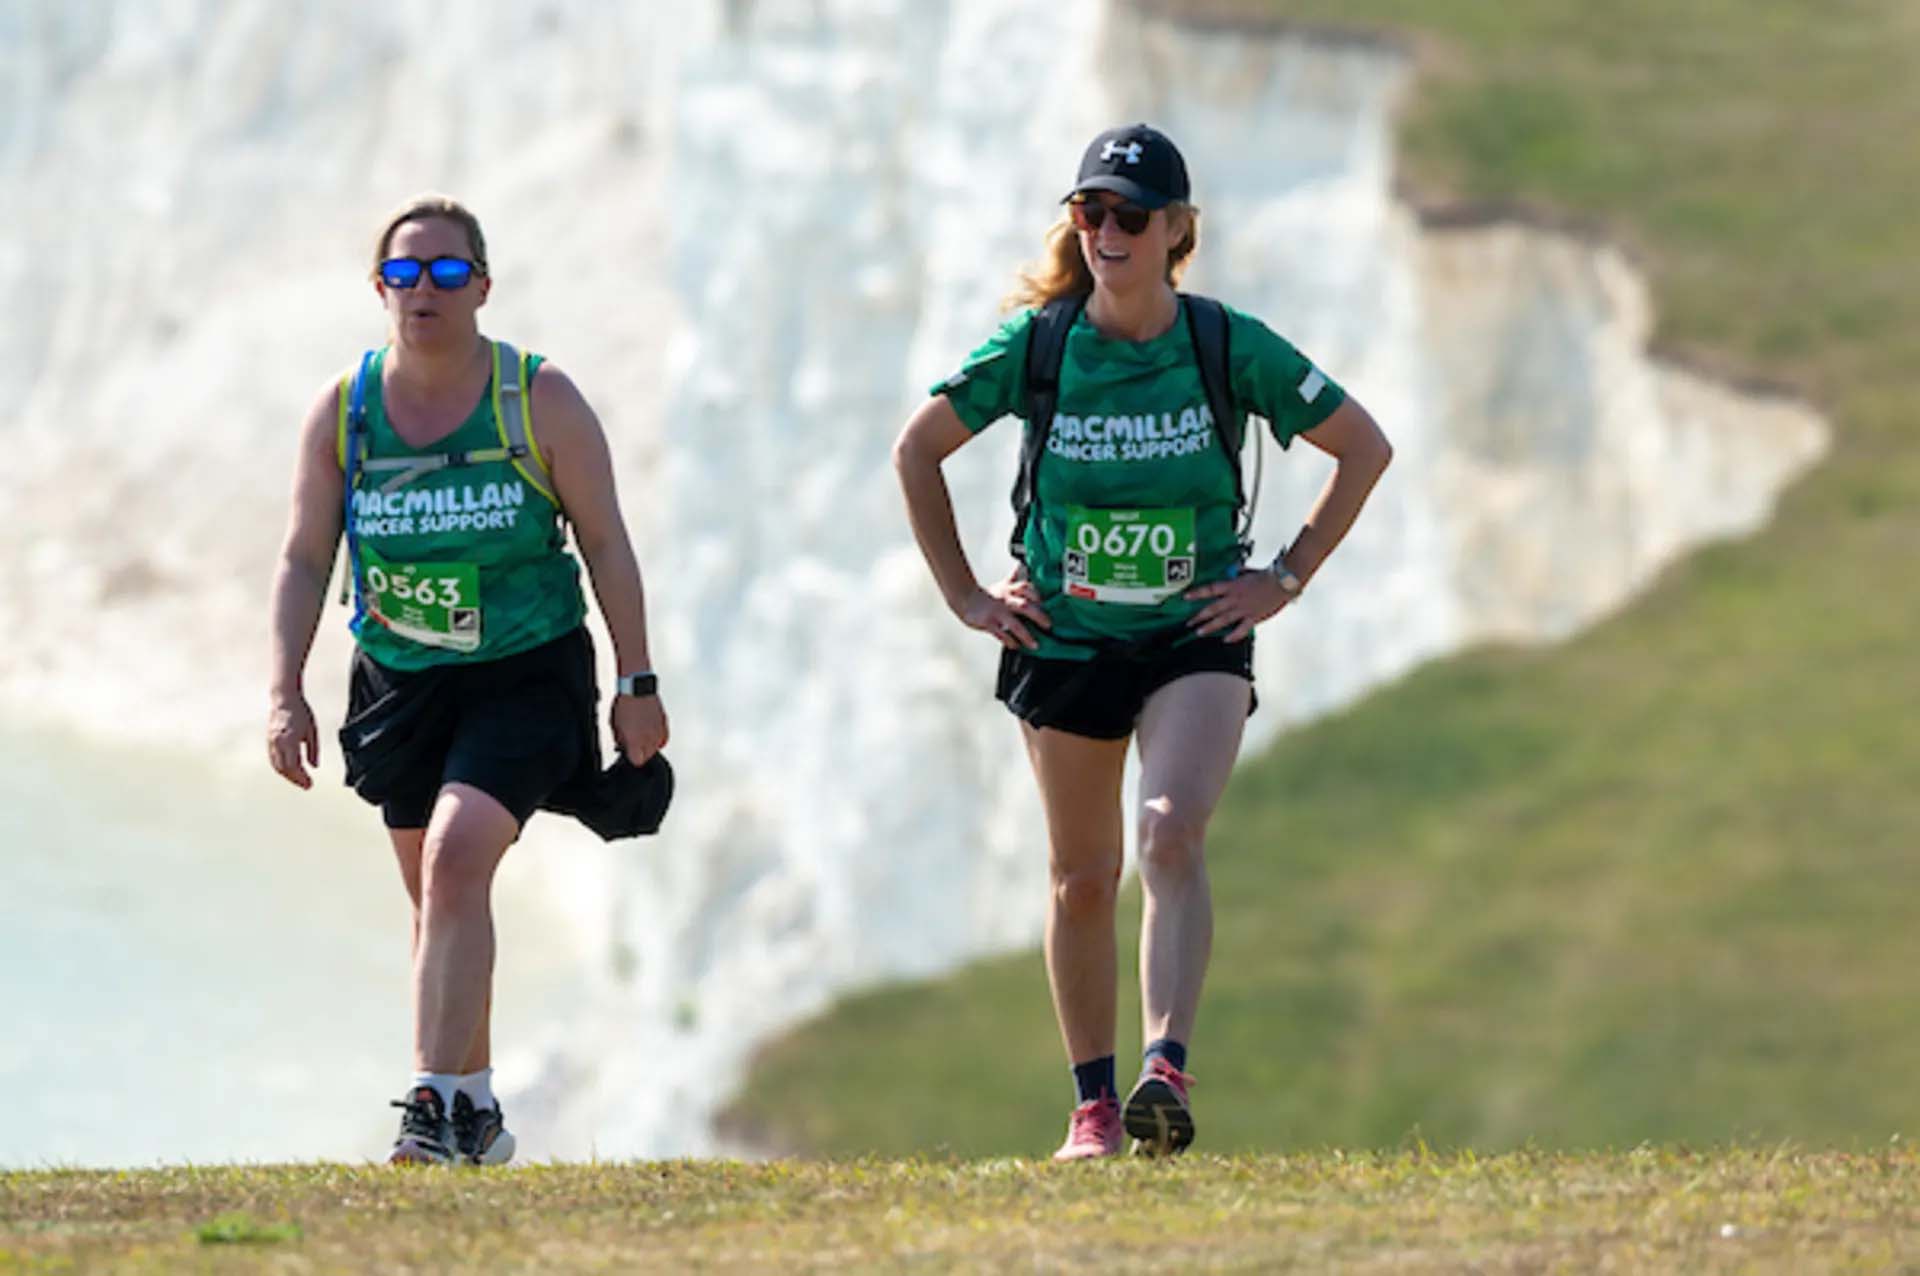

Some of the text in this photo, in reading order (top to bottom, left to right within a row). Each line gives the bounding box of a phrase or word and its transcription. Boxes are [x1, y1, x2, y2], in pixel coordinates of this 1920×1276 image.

[1120, 430, 1211, 460] SUPPORT
[355, 509, 518, 536] ANCER SUPPORT
[1078, 523, 1175, 557] 0670
[367, 565, 461, 607] 0563
